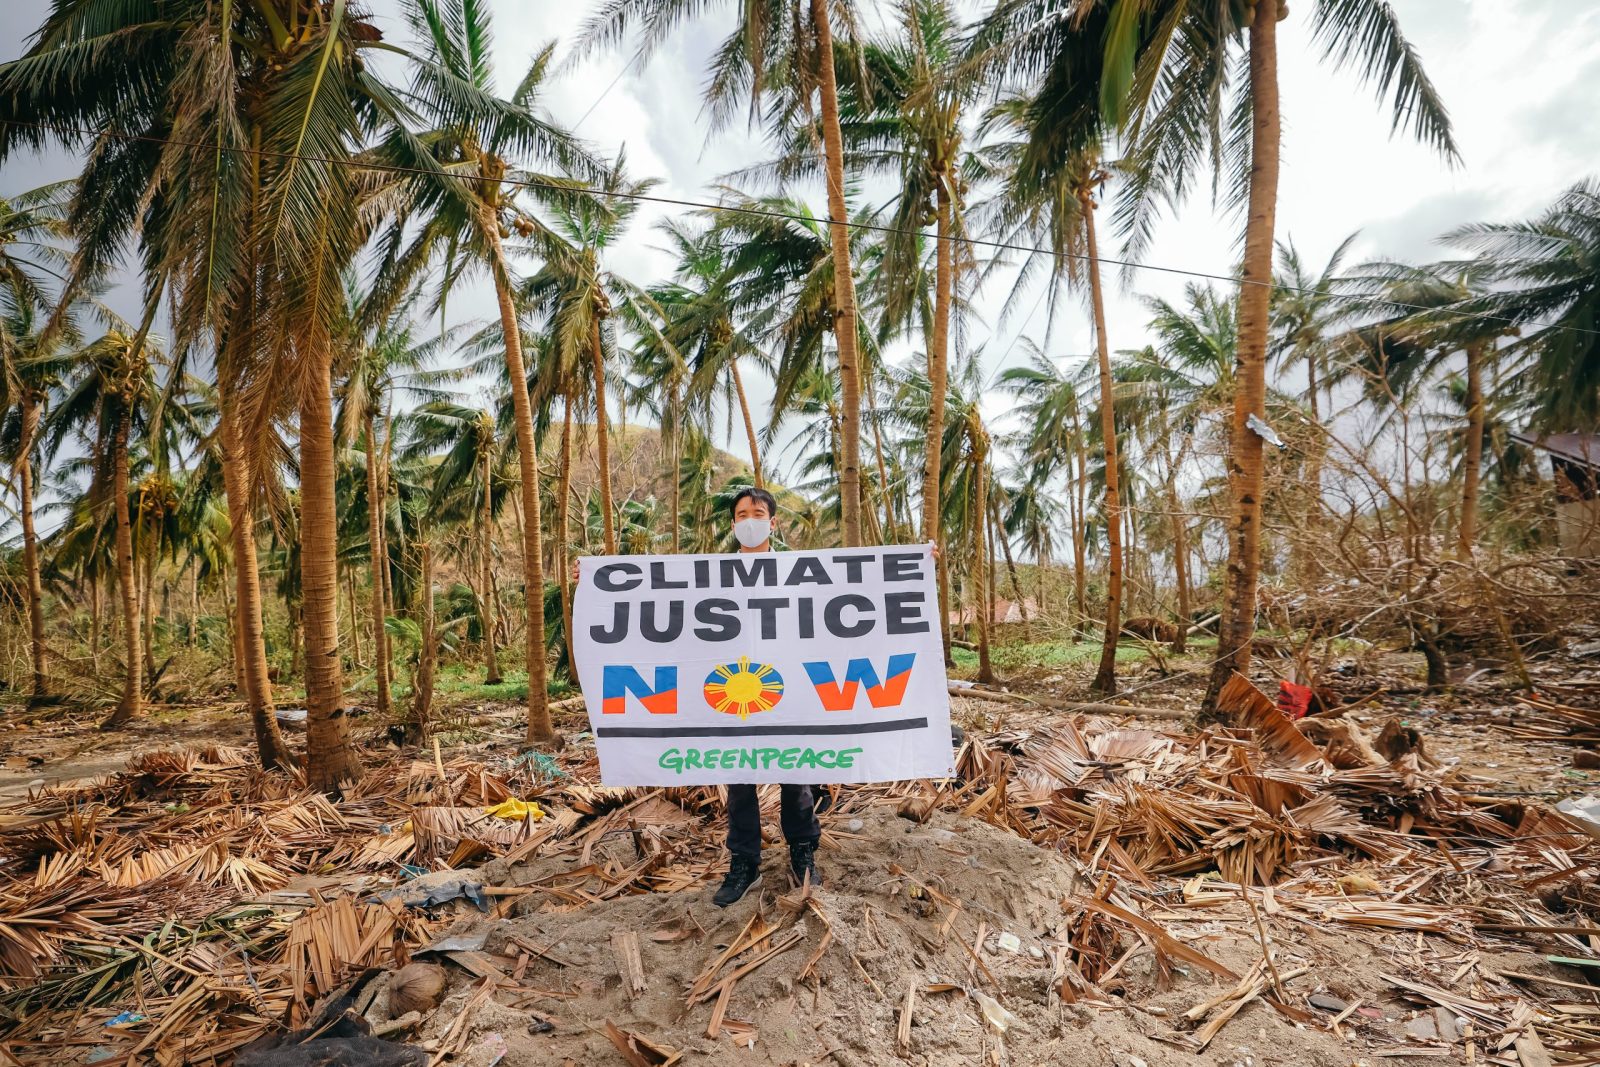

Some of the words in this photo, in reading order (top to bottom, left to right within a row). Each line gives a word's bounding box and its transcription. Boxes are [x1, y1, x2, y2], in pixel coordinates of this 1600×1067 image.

[593, 552, 925, 592] CLIMATE
[589, 591, 930, 644] JUSTICE
[602, 652, 917, 719] NOW
[658, 747, 864, 774] GREENPEACE
